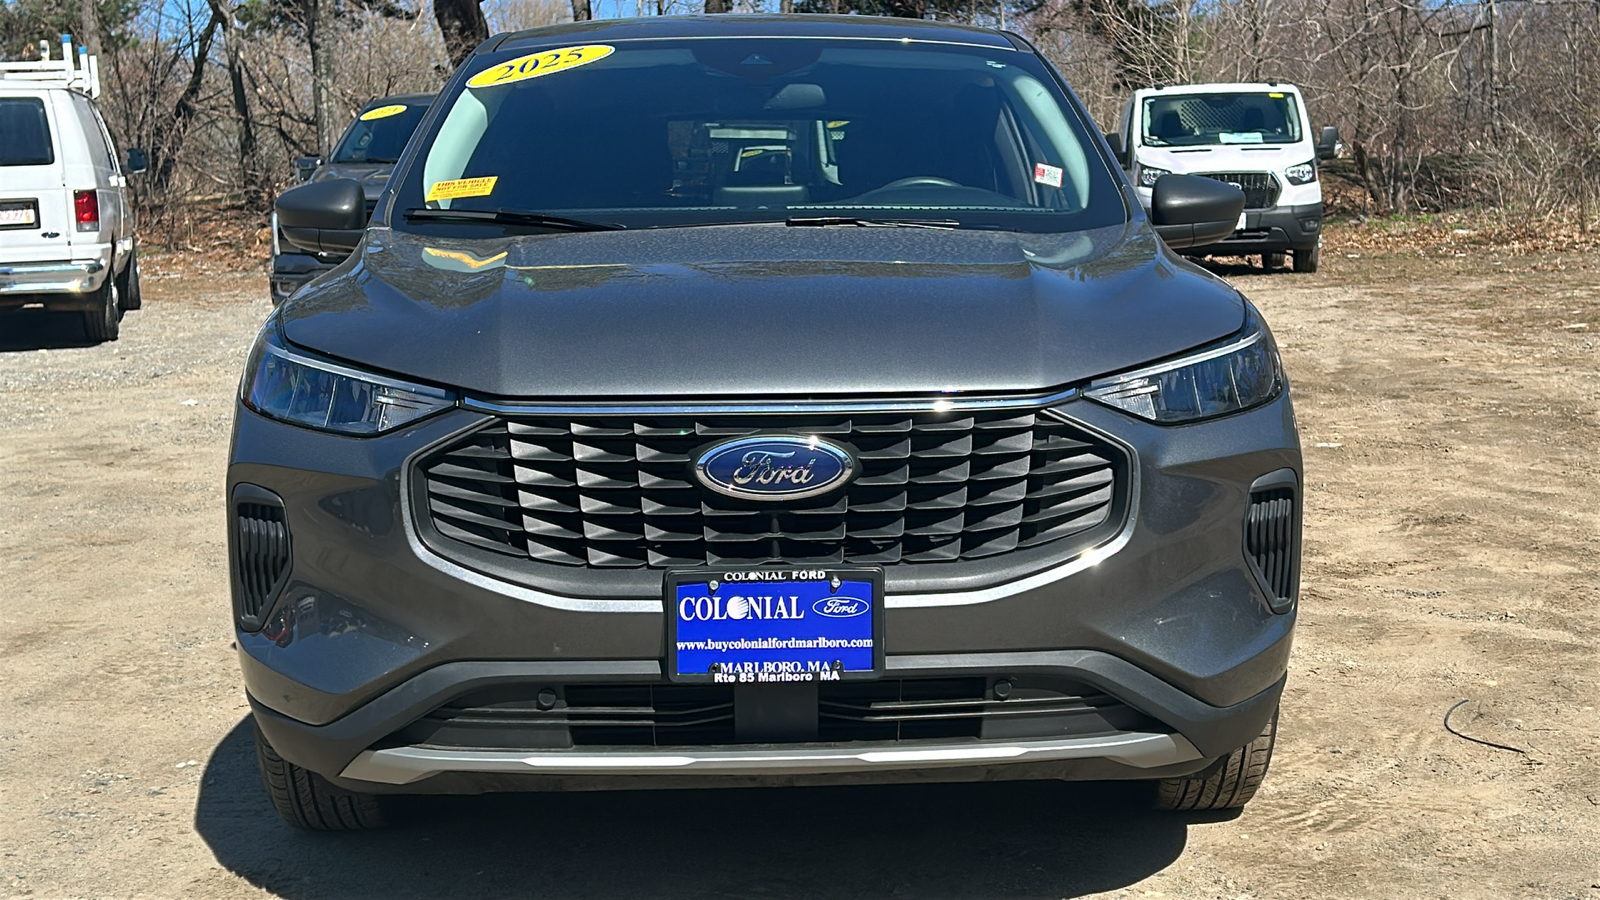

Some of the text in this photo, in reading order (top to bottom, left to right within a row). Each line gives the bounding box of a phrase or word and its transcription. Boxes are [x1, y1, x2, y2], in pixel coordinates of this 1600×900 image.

[494, 47, 585, 82] 2025
[733, 450, 817, 485] Ford
[724, 570, 826, 581] COLONIAL FORD
[679, 595, 805, 622] COLONIAL
[676, 636, 874, 653] www.buycolonialfordmarlboro.com
[807, 660, 831, 673] MA
[714, 671, 841, 684] Rte 85 Marlboro MA
